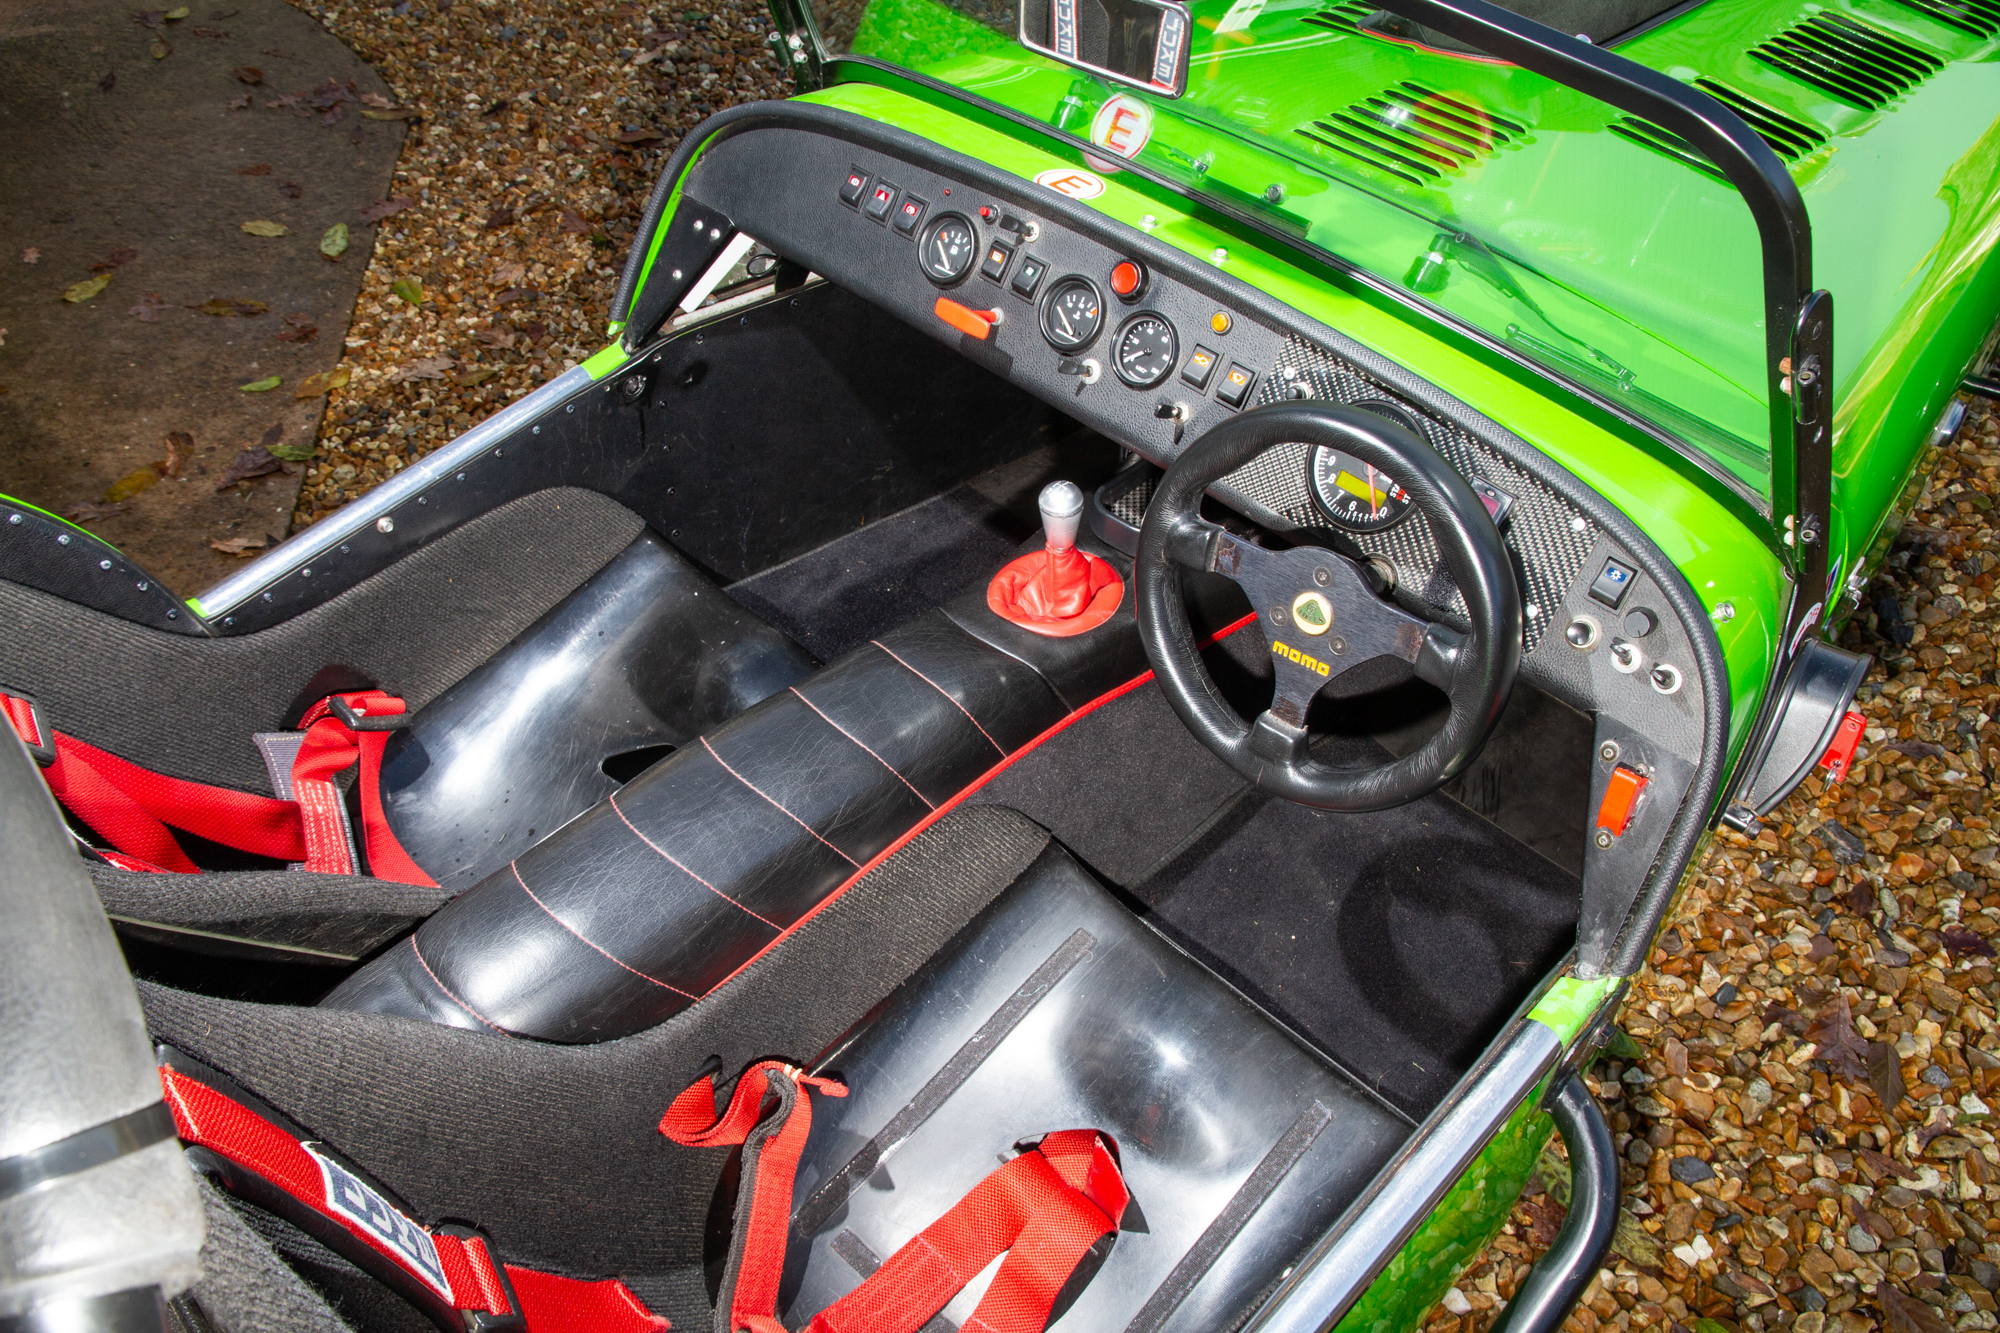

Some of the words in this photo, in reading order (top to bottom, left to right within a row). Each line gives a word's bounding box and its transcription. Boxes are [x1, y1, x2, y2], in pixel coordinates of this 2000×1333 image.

[1103, 106, 1140, 154] E
[1049, 175, 1093, 195] E
[1328, 455, 1336, 466] 9
[1328, 473, 1337, 484] 8
[1336, 489, 1345, 500] 7
[1348, 500, 1358, 512] 6
[1379, 506, 1388, 517] 0
